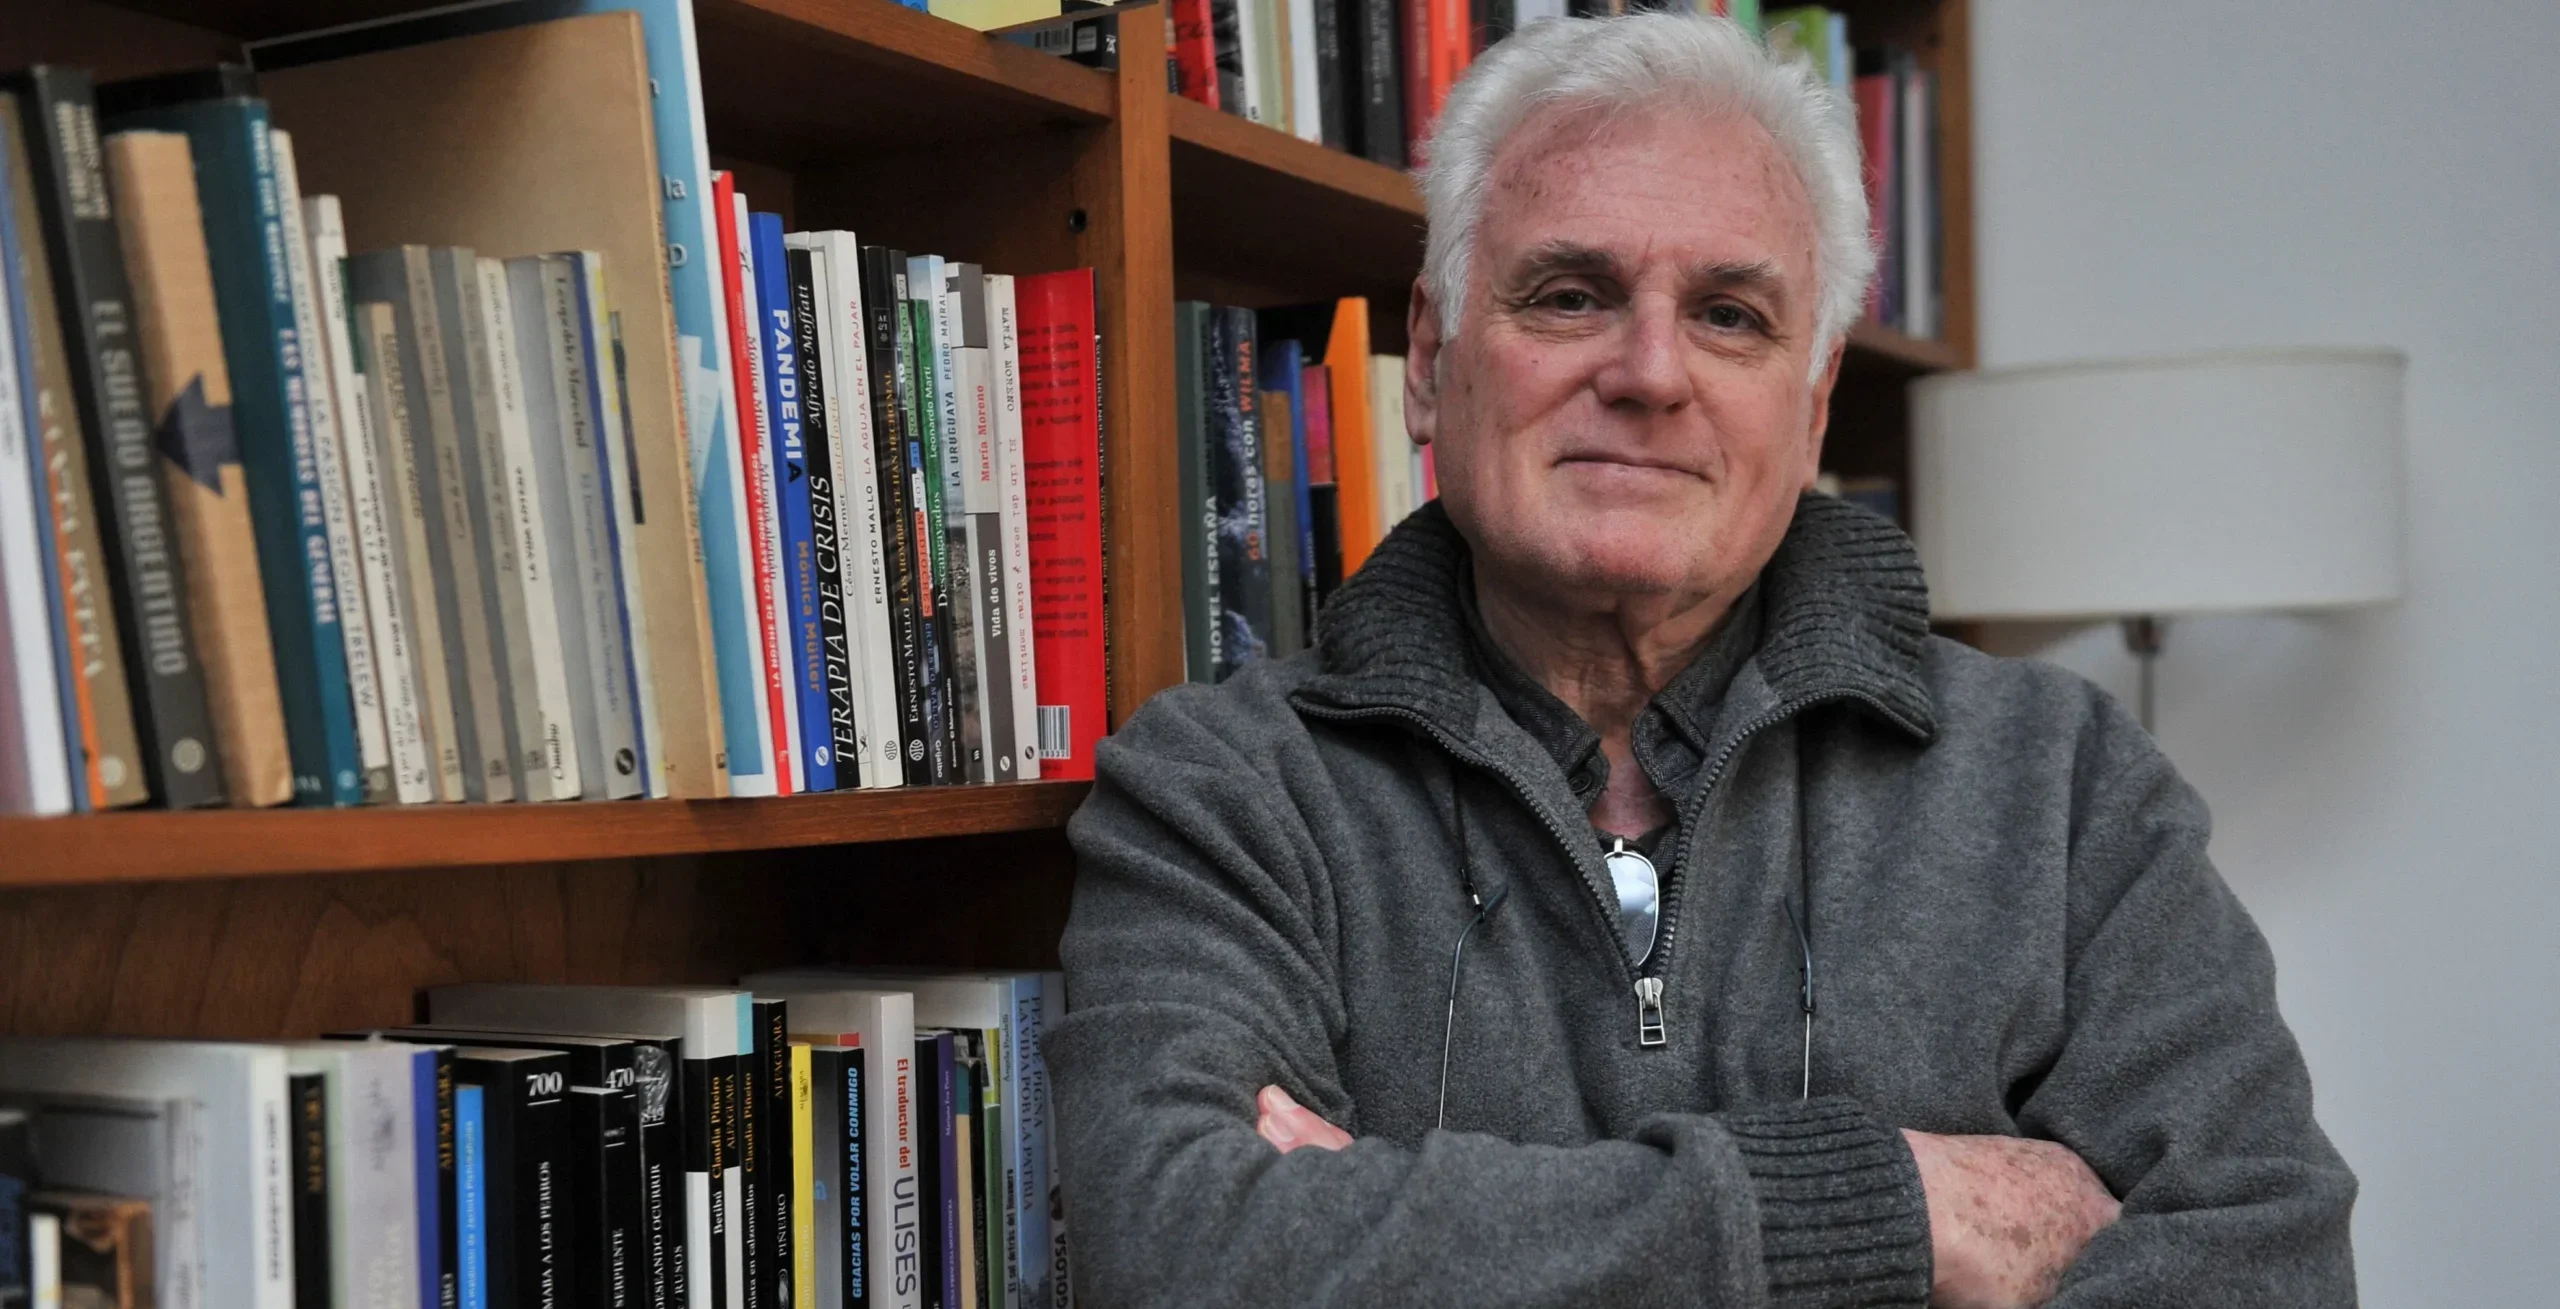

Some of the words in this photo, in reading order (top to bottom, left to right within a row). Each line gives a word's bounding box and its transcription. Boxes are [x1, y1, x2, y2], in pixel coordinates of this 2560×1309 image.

[897, 276, 906, 297] LA
[795, 283, 816, 355] Moffatt
[849, 299, 860, 348] PAJAR
[938, 292, 948, 336] MAIRAL
[1001, 306, 1013, 349] MARÍA
[747, 334, 759, 394] Mónica
[853, 355, 862, 370] EL
[882, 369, 892, 400] MAL
[923, 364, 933, 394] Martí
[942, 341, 952, 380] PEDRO
[1237, 340, 1251, 412] WILMA
[773, 309, 802, 483] PANDEMIA
[802, 358, 823, 429] Alfredo
[855, 377, 864, 395] EN
[1004, 359, 1014, 412] MORENO
[753, 398, 766, 450] Müller
[858, 402, 869, 449] AGUJA
[885, 403, 896, 451] HECHO
[925, 397, 937, 459] Leonardo
[944, 390, 958, 463] URUGUAYA
[975, 384, 986, 436] Moreno
[911, 445, 918, 465] DE
[978, 441, 990, 482] María
[1008, 437, 1017, 453] El
[1242, 419, 1255, 458] con
[92, 297, 126, 338] EL
[123, 472, 187, 678] ARGENTINO
[751, 452, 761, 504] LARGOS
[759, 462, 769, 482] Mi
[862, 456, 871, 474] LA
[889, 454, 899, 485] HAN
[951, 469, 961, 487] LA
[1010, 462, 1018, 486] fin
[864, 484, 876, 533] MALLO
[892, 487, 901, 504] TE
[914, 476, 922, 506] LOS
[1012, 494, 1021, 516] del
[1245, 466, 1258, 525] horas
[756, 506, 769, 573] BASTONES
[811, 475, 838, 584] CRISIS
[837, 492, 849, 551] Mermer
[894, 507, 906, 571] HOMBRES
[1013, 525, 1022, 557] sexo
[1203, 495, 1219, 584] ESPAÑA
[765, 524, 778, 580] alemán
[917, 514, 930, 613] MEDIOCRES
[930, 492, 950, 607] Descangayados
[986, 548, 997, 584] vivos
[1013, 565, 1022, 573] y
[1248, 532, 1259, 560] 60
[763, 576, 772, 600] LOS
[797, 541, 812, 616] Mónica
[842, 555, 853, 596] César
[870, 539, 882, 604] ERNESTO
[897, 573, 909, 601] LOS
[988, 587, 999, 603] de
[766, 603, 773, 619] DE
[821, 590, 841, 625] DE
[990, 607, 1001, 637] Vida
[1016, 582, 1026, 619] otras
[768, 622, 779, 668] NOCHE
[900, 606, 914, 656] MALLO
[1208, 591, 1222, 663] HOTEL
[350, 623, 374, 708] TRELEW
[804, 622, 821, 693] Müller
[925, 622, 936, 681] ERNESTO
[1018, 628, 1030, 690] mentiras
[773, 672, 780, 688] LA
[826, 633, 855, 762] TERAPIA
[905, 659, 919, 722] ERNESTO
[930, 685, 940, 729] MALLO
[934, 739, 943, 776] Grijalbo
[1019, 997, 1029, 1022] LA
[1030, 995, 1041, 1063] FELIPE
[772, 1014, 783, 1099] ALFAGUARA
[897, 1058, 907, 1070] El
[1020, 1026, 1030, 1072] VIDA
[526, 1071, 563, 1097] 700
[604, 1067, 635, 1089] 470
[710, 1076, 720, 1123] Piñeiro
[743, 1072, 752, 1117] Piñeiro
[848, 1067, 858, 1137] CONMIGO
[1021, 1075, 1031, 1113] POR
[1032, 1069, 1043, 1128] PIGNA
[724, 1073, 735, 1150] ALFAGUARA
[898, 1074, 908, 1141] traductor
[1022, 1118, 1031, 1142] LA
[711, 1128, 721, 1178] Claudia
[744, 1122, 753, 1172] Claudia
[850, 1142, 859, 1191] VOLAR
[899, 1146, 909, 1168] del
[539, 1161, 551, 1219] PERROS
[649, 1163, 662, 1230] OCURRIR
[1022, 1145, 1033, 1212] PATRIA
[712, 1190, 723, 1233] Betibú
[745, 1183, 755, 1255] calzoncillos
[776, 1192, 787, 1256] PIÑEIRO
[850, 1196, 860, 1226] POR
[540, 1222, 551, 1250] LOS
[541, 1254, 552, 1264] A
[893, 1175, 917, 1296] ULISES
[612, 1228, 624, 1308] SERPIENTE
[652, 1235, 666, 1309] DESEANDO
[671, 1244, 685, 1293] RUSOS
[748, 1259, 756, 1274] en
[851, 1231, 861, 1298] GRACIAS
[1007, 1282, 1015, 1292] El
[1055, 1232, 1067, 1308] GOLOSA
